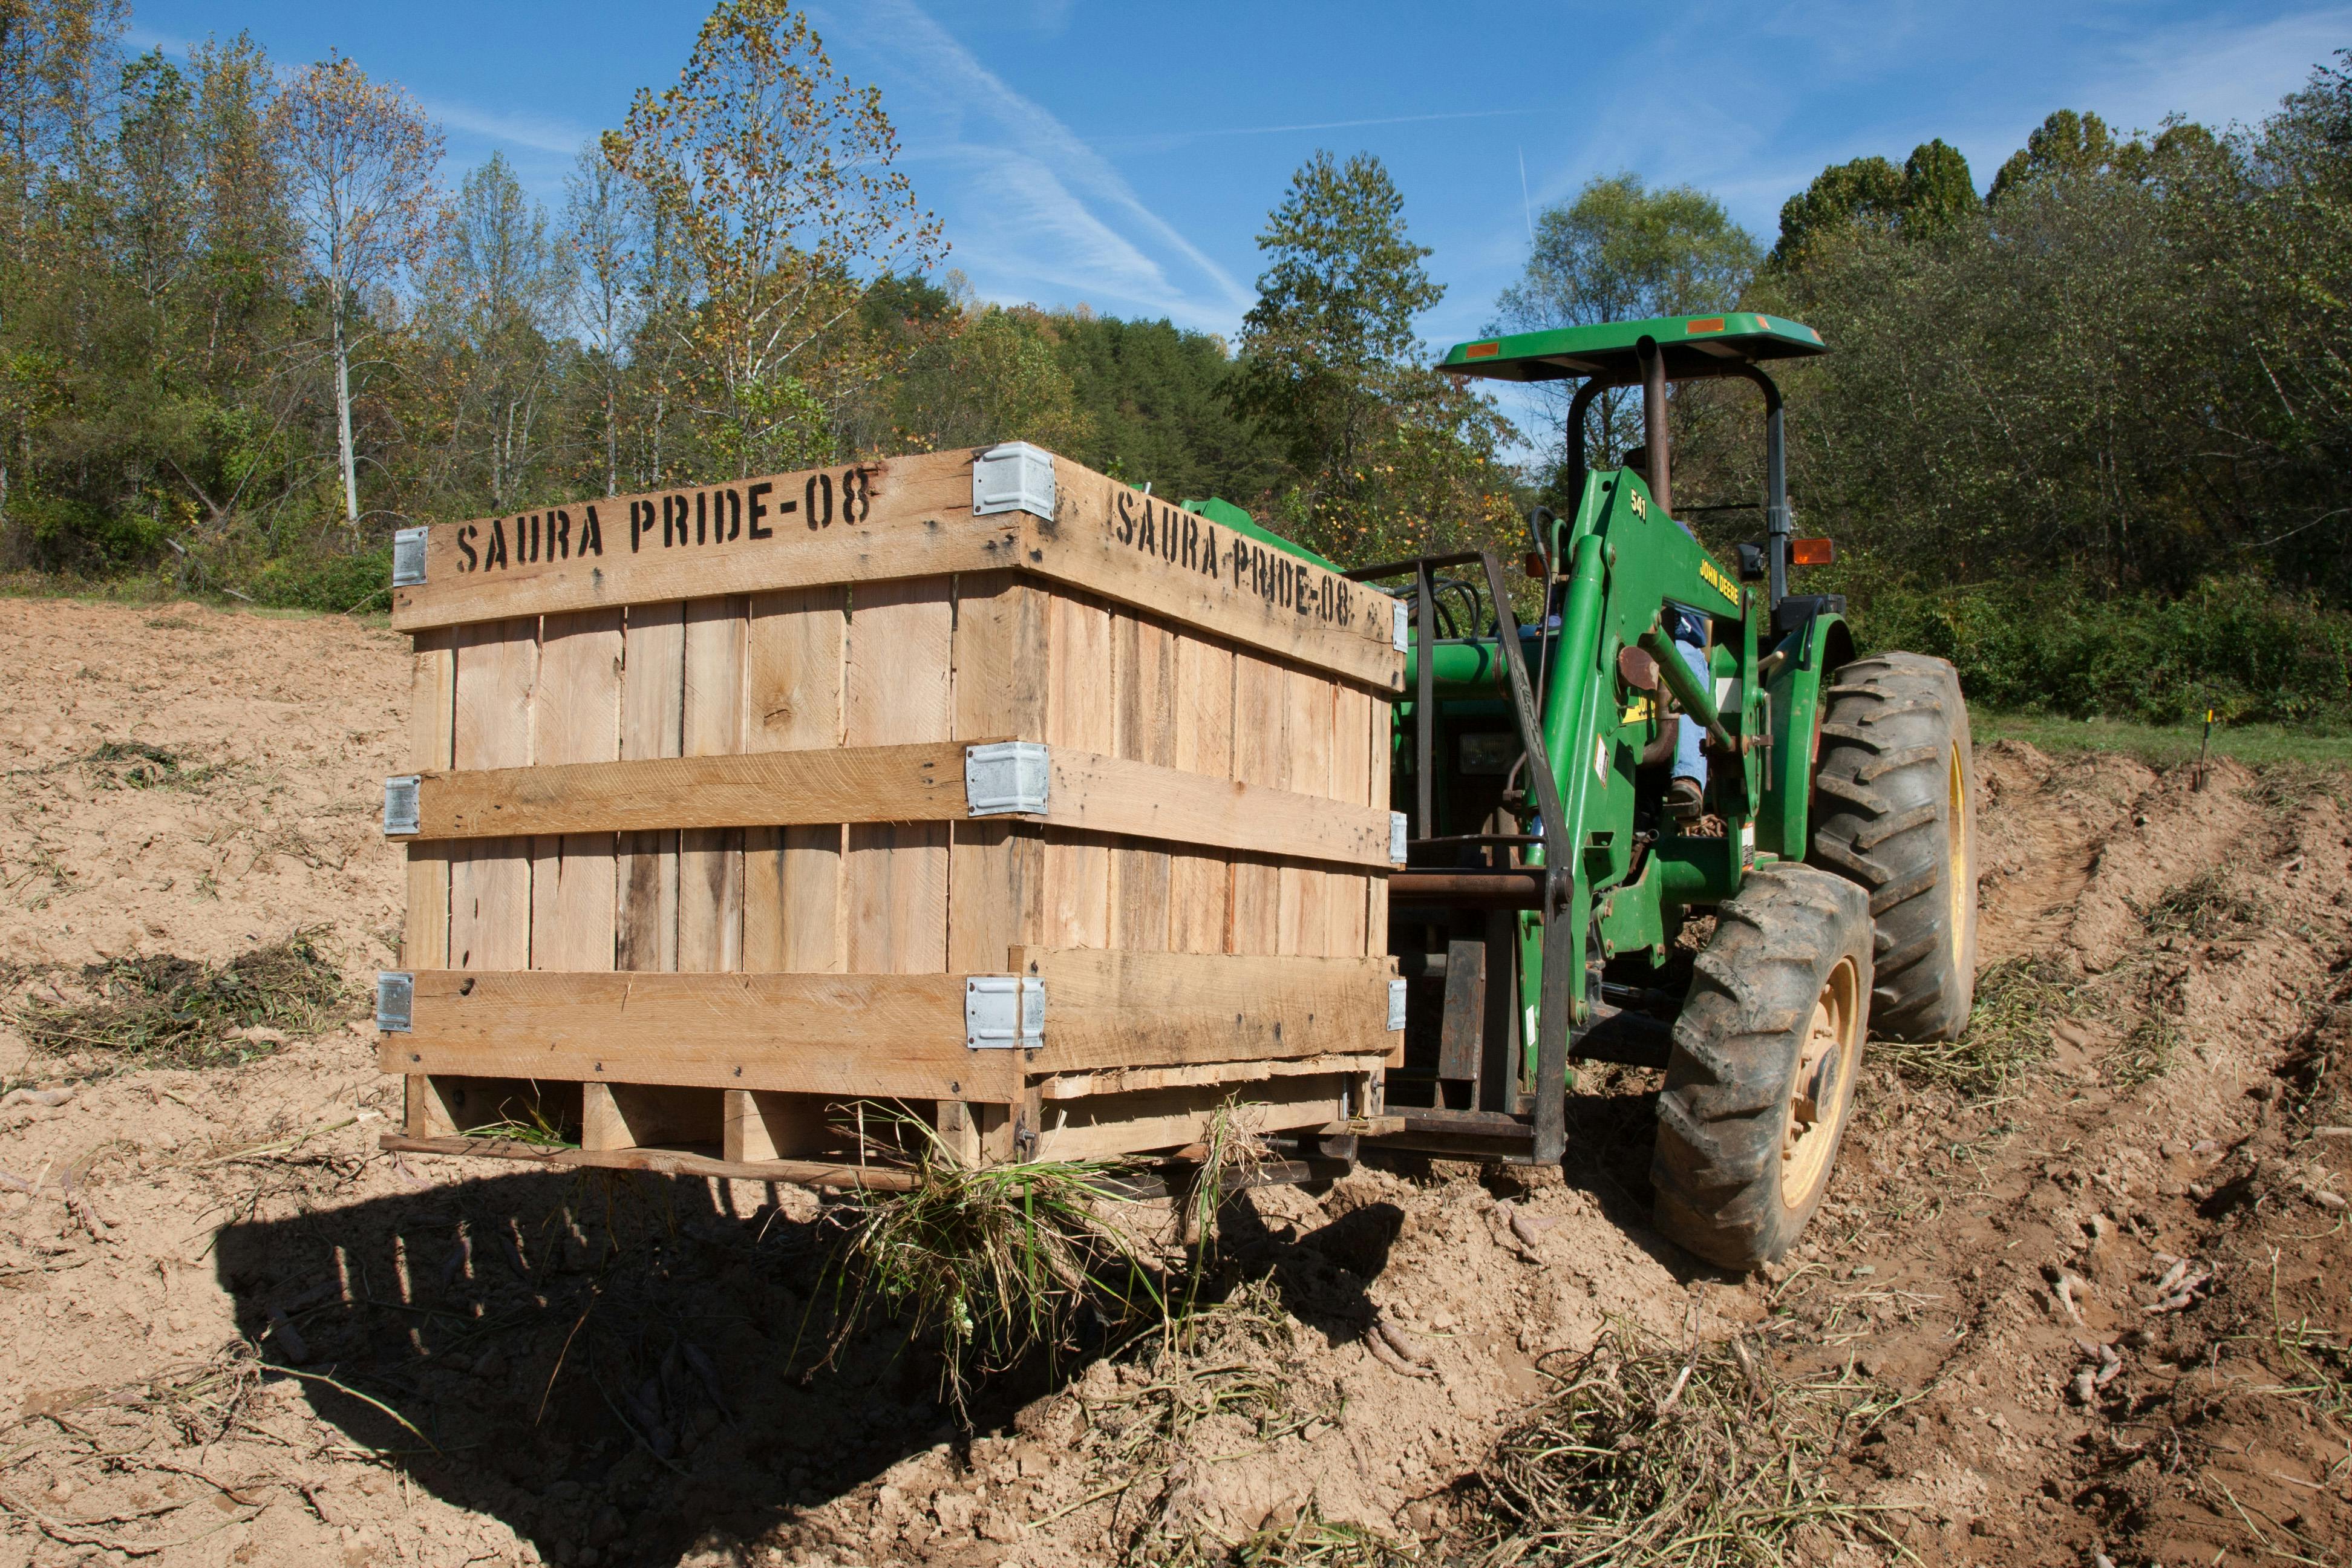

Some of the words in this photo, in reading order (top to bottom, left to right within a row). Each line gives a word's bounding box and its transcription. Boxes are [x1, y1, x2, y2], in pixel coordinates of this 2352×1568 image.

[457, 505, 604, 573] SAURA
[630, 468, 869, 554] PRIDE-08
[1631, 488, 1645, 521] 541
[1117, 491, 1218, 580] SAURA
[1233, 538, 1349, 627] PRIDE-08
[1700, 559, 1717, 589] JOHN
[1719, 574, 1739, 606] DEERE
